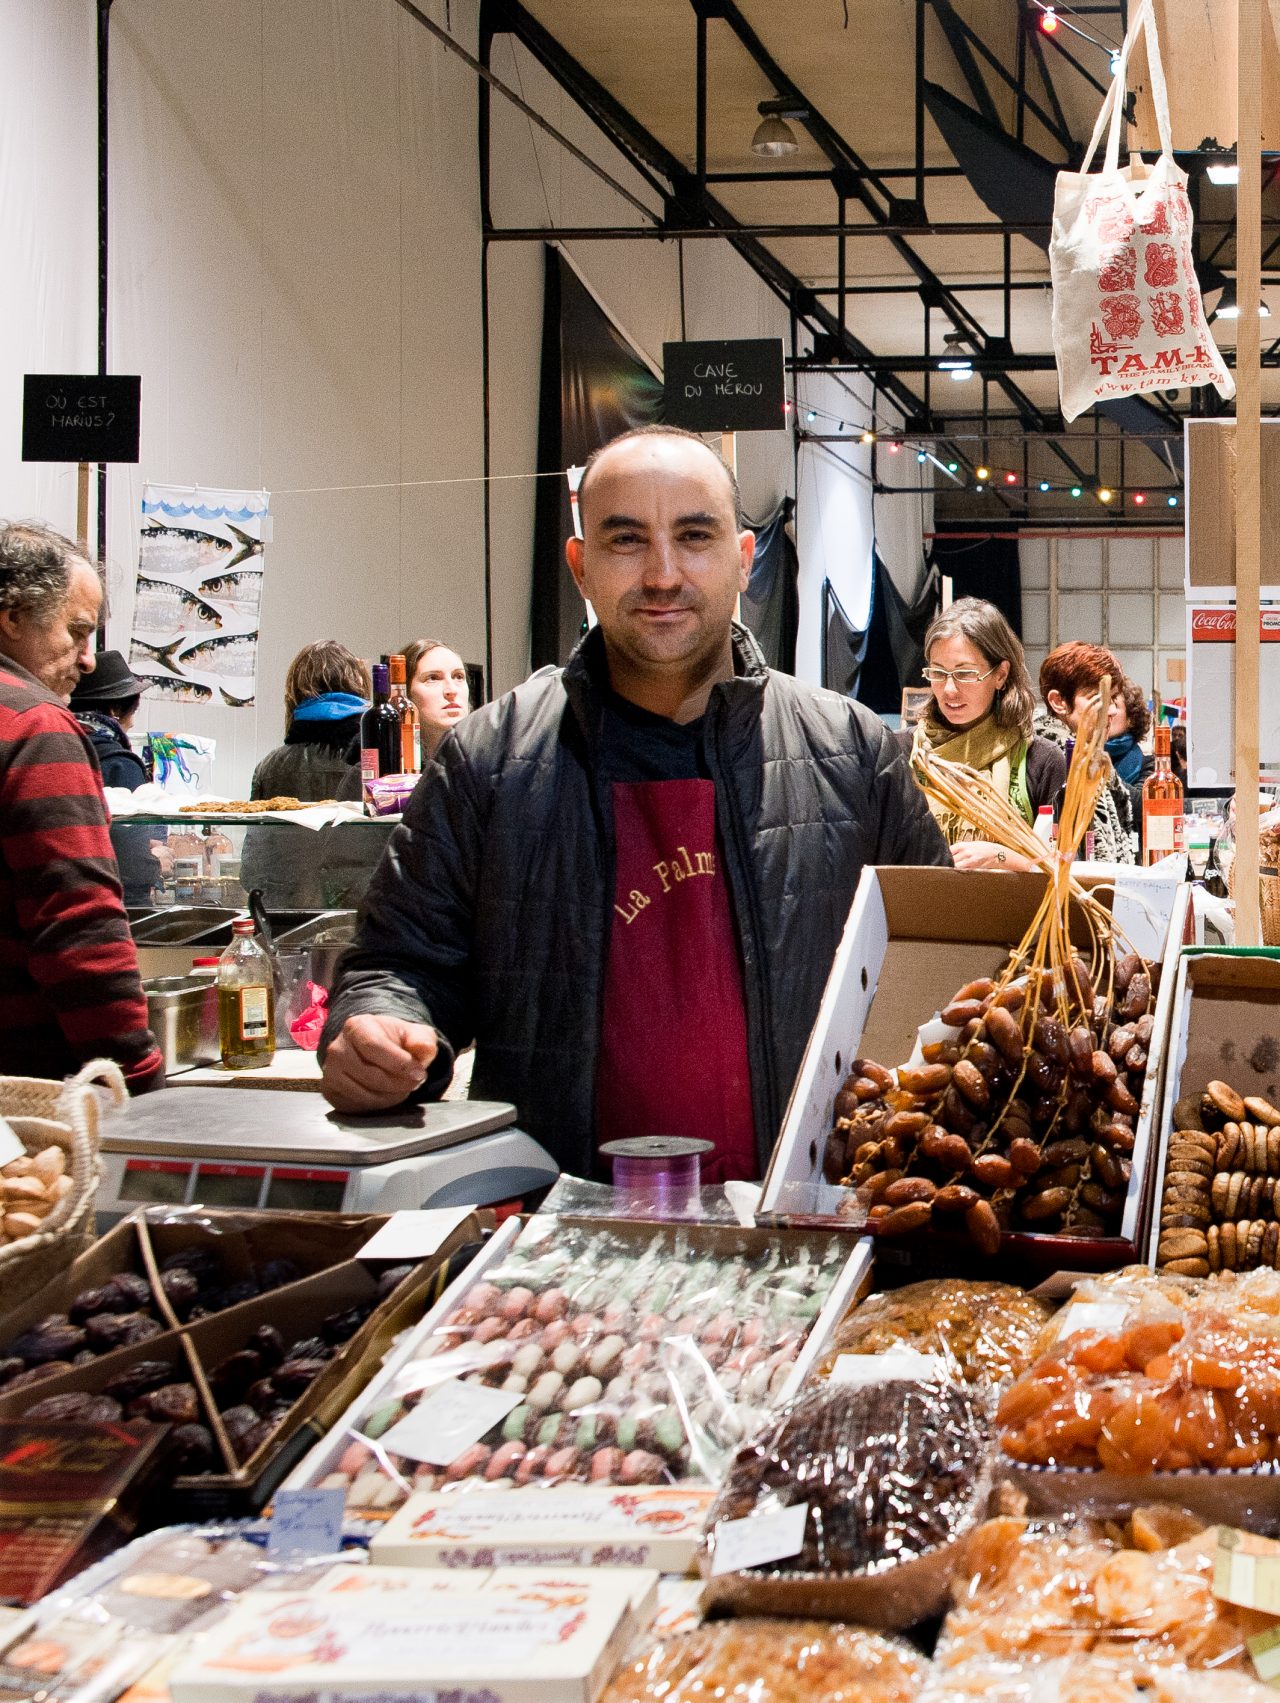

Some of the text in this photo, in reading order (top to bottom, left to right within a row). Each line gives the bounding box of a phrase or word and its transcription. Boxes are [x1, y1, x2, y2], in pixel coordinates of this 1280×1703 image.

[1091, 345, 1212, 375] TAM-K
[694, 362, 738, 378] CAVE
[1142, 367, 1179, 376] FAMILY
[46, 388, 107, 410] OÙ EST
[685, 385, 702, 397] DU
[614, 846, 716, 925] La Palm
